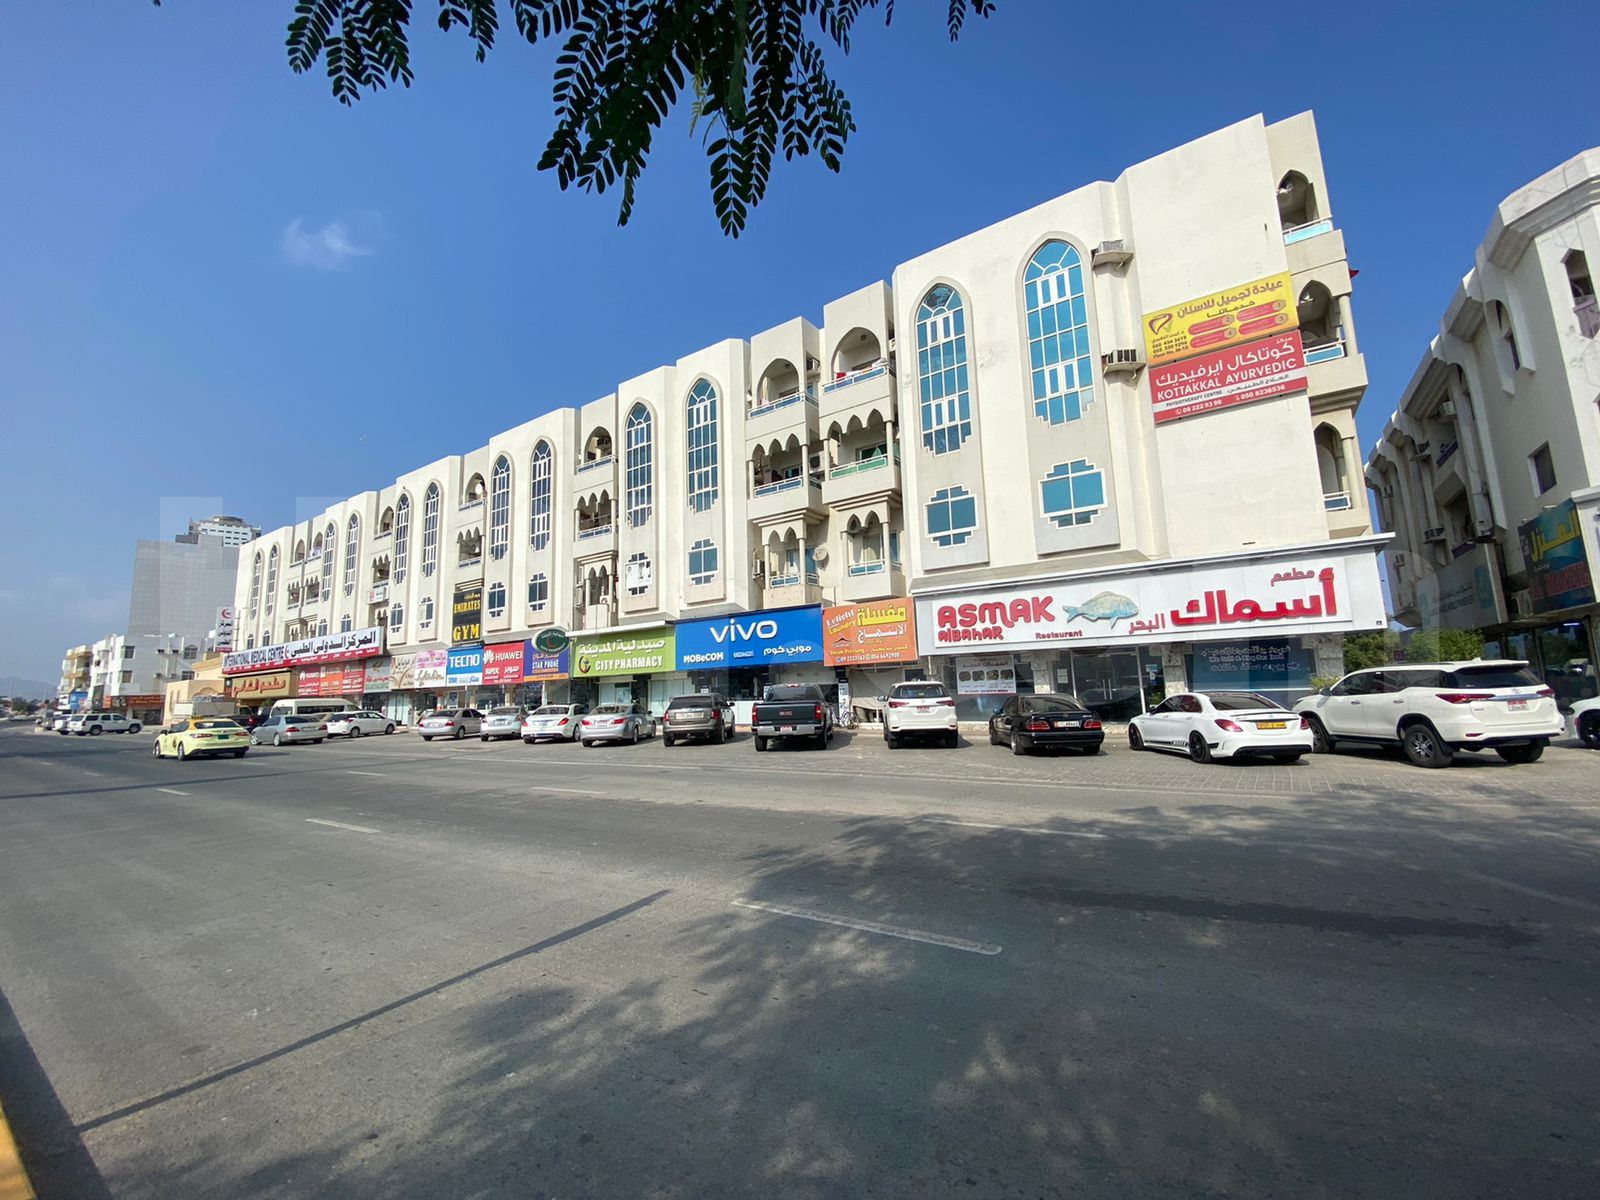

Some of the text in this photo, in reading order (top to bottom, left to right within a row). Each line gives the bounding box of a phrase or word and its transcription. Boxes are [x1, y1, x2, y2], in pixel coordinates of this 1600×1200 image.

[1252, 280, 1283, 294] عيادة
[1216, 288, 1251, 306] تجميل
[1156, 342, 1295, 387] كوتاكال ايرفيديك
[1157, 358, 1297, 401] KOTTAKKAL AYURVEDIC
[1166, 390, 1222, 407] PHYSIOTHERAPY CENTRE
[1240, 392, 1254, 400] 050
[1192, 403, 1204, 412] 222
[1204, 401, 1213, 409] 93
[1271, 567, 1316, 587] مطعم
[453, 600, 481, 613] EMIRATES
[1129, 567, 1337, 634] أسماك البحر
[857, 604, 906, 626] مغسلة
[453, 624, 480, 641] GYM
[710, 618, 778, 643] vivo
[1035, 630, 1083, 640] Restaurant
[345, 631, 377, 650] المركز
[578, 639, 666, 658] صيدلية المدينة
[223, 650, 250, 668] INTERNATIONAL
[250, 647, 267, 664] MEDICAL
[267, 645, 284, 661] CENTRE
[495, 650, 523, 661] HUAWEI
[763, 645, 785, 656] كوم
[785, 645, 812, 656] موبي
[448, 653, 481, 669] TECNO
[532, 659, 560, 669] STAR PHONE
[595, 655, 663, 671] CITY PHARMACY
